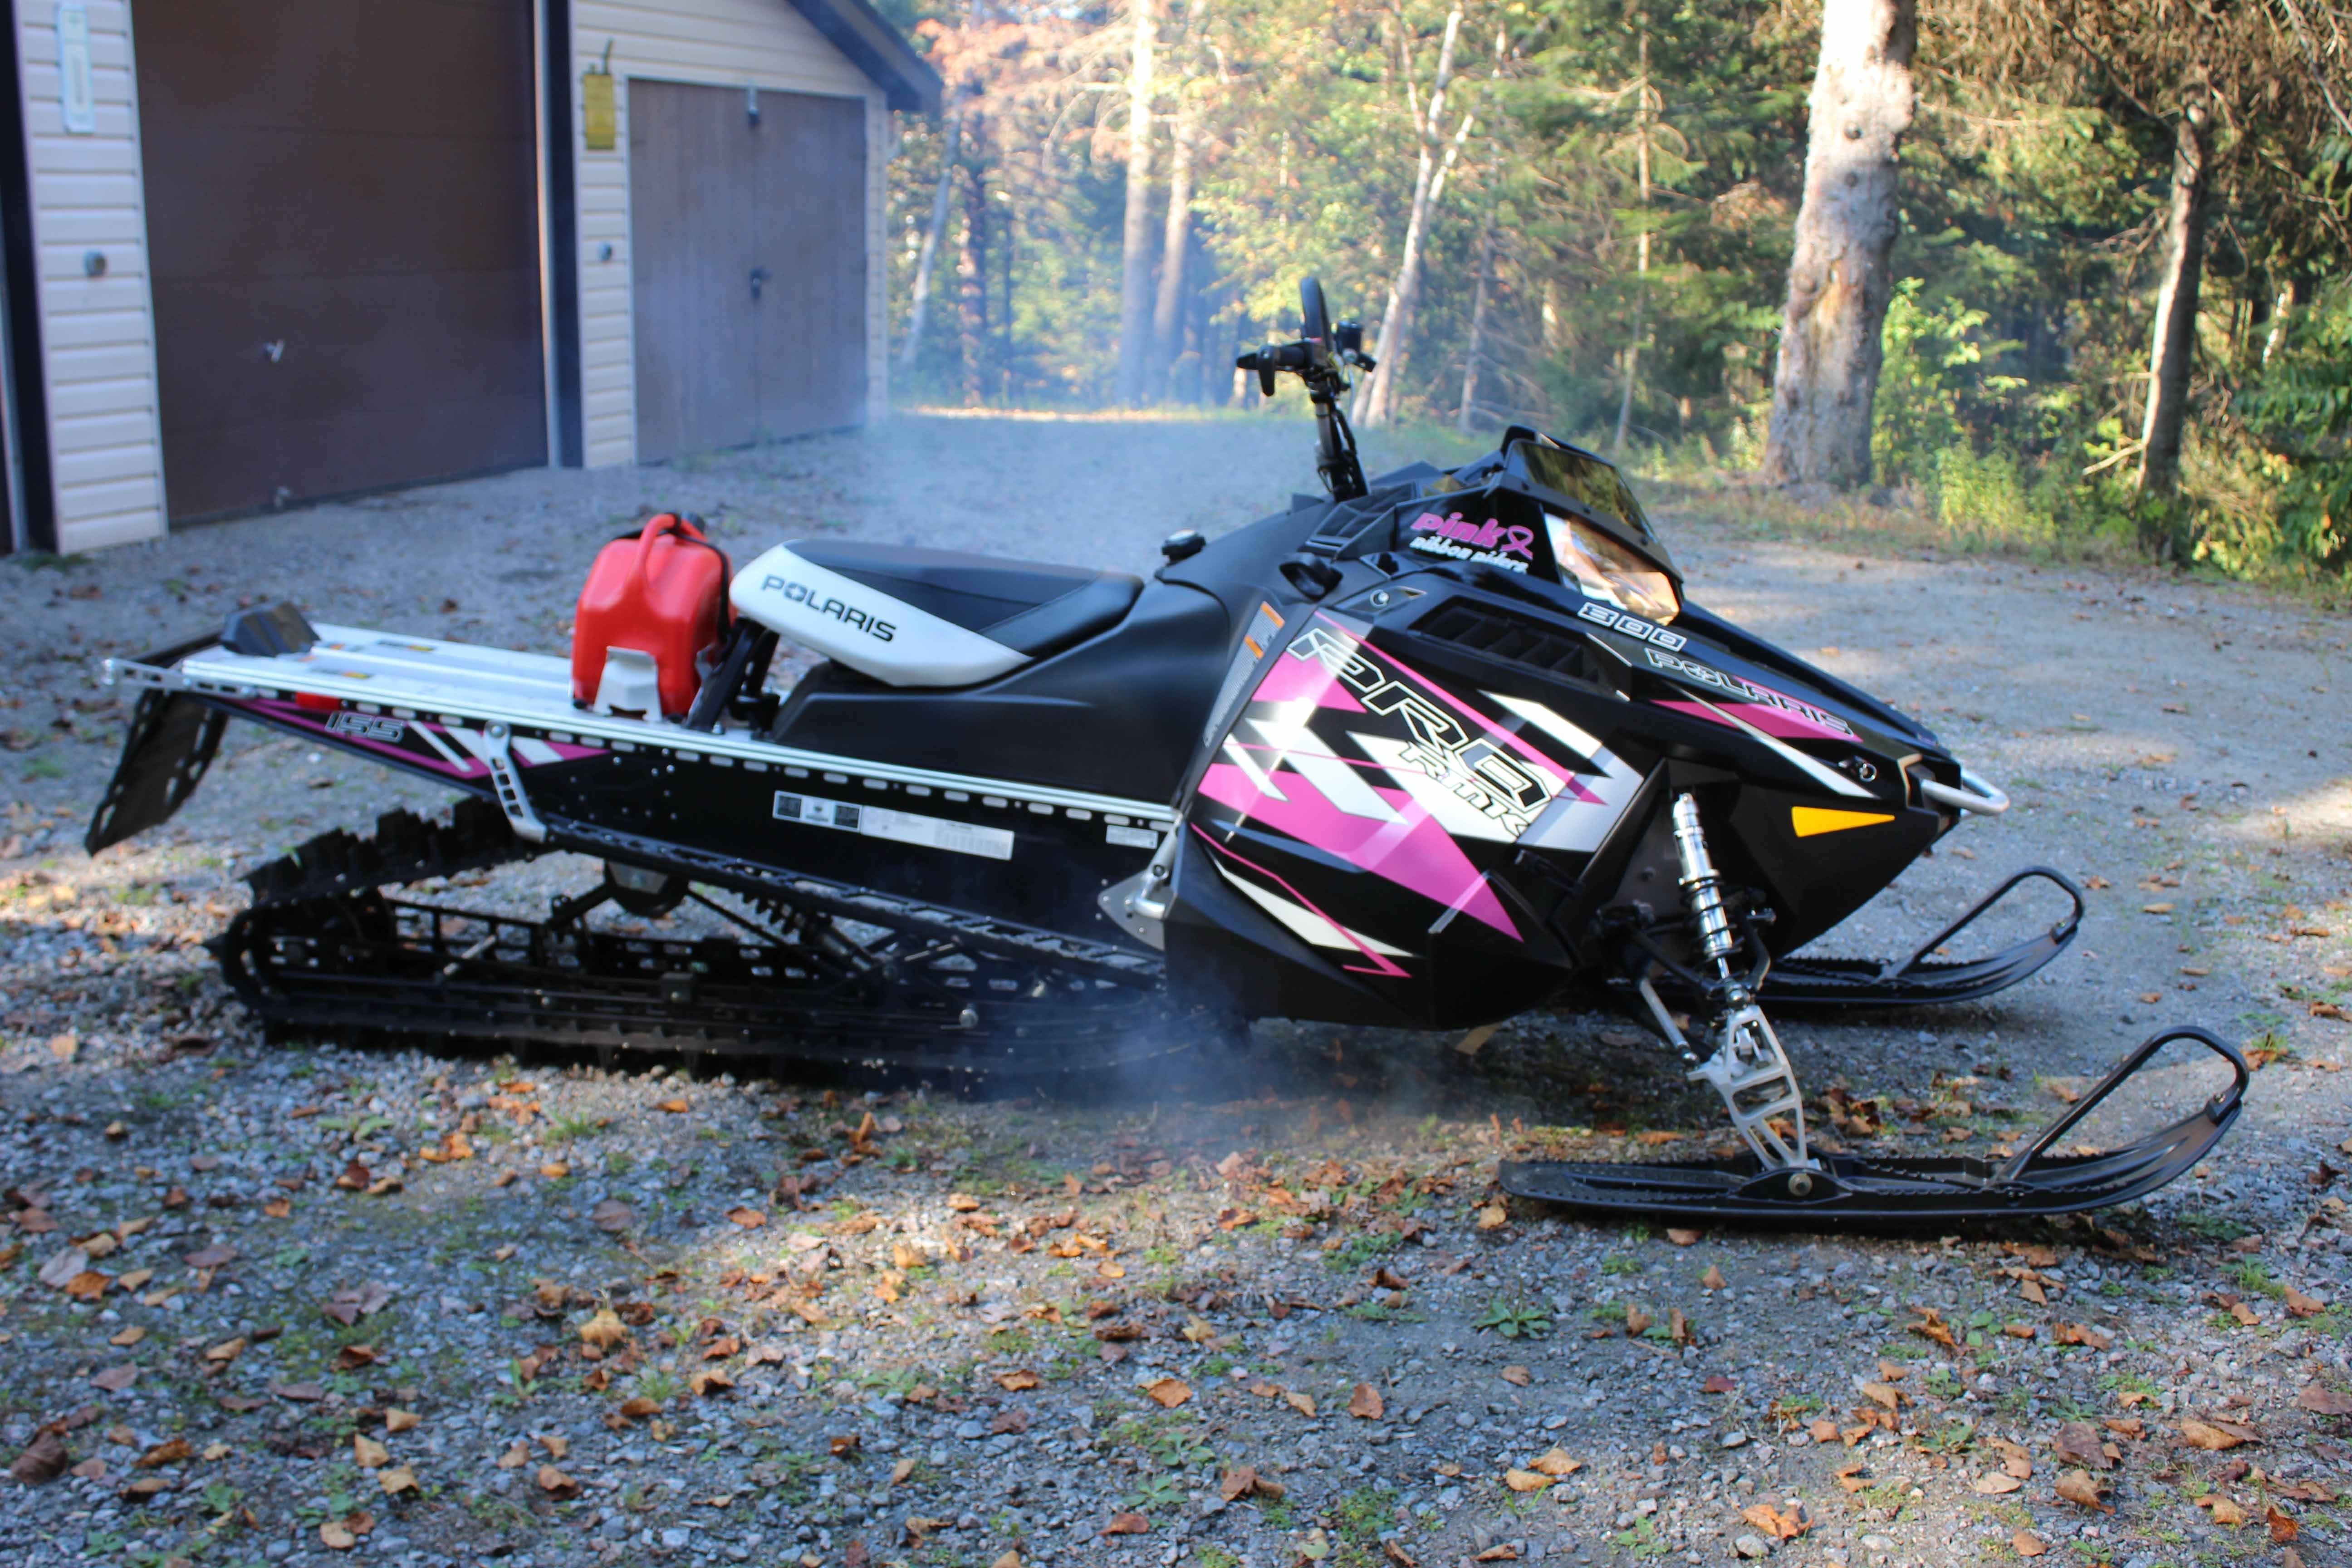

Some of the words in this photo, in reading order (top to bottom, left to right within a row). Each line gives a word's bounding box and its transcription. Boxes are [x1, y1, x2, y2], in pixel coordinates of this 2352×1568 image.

[761, 574, 897, 643] POLARIS
[1577, 601, 1687, 652] 800
[324, 710, 404, 743] 155
[1288, 627, 1552, 813] PRO
[1645, 647, 1854, 737] POLARIS
